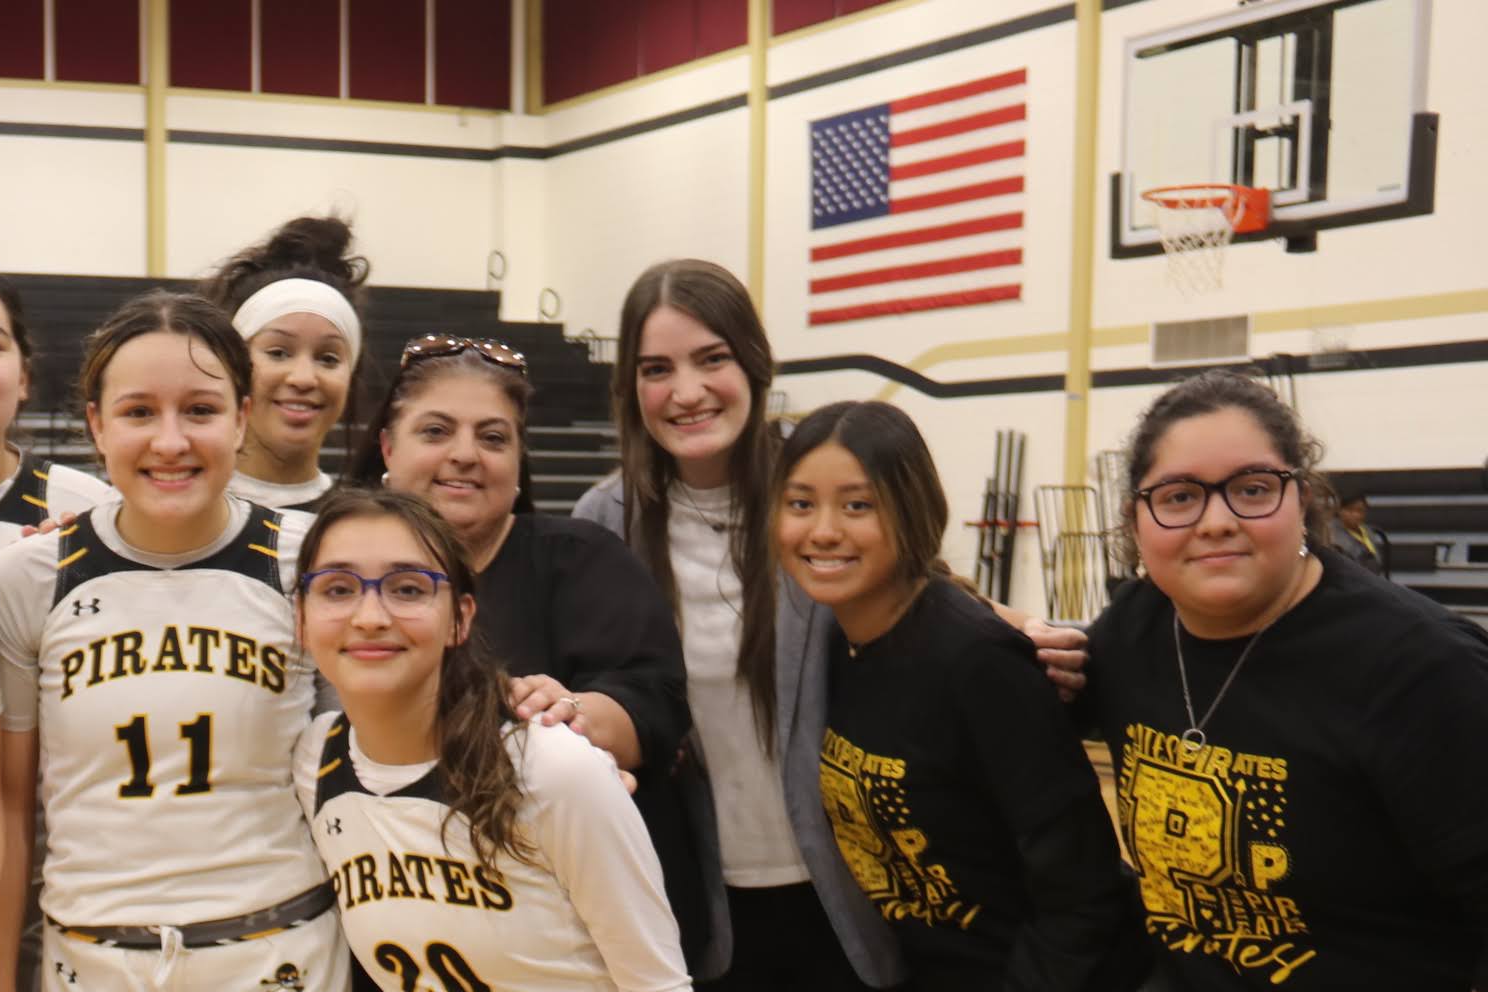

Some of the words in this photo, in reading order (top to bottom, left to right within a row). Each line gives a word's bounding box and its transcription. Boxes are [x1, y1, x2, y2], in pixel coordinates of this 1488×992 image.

[60, 624, 288, 702] PIRATES
[113, 712, 214, 799] 11
[330, 850, 514, 912] PIRATES
